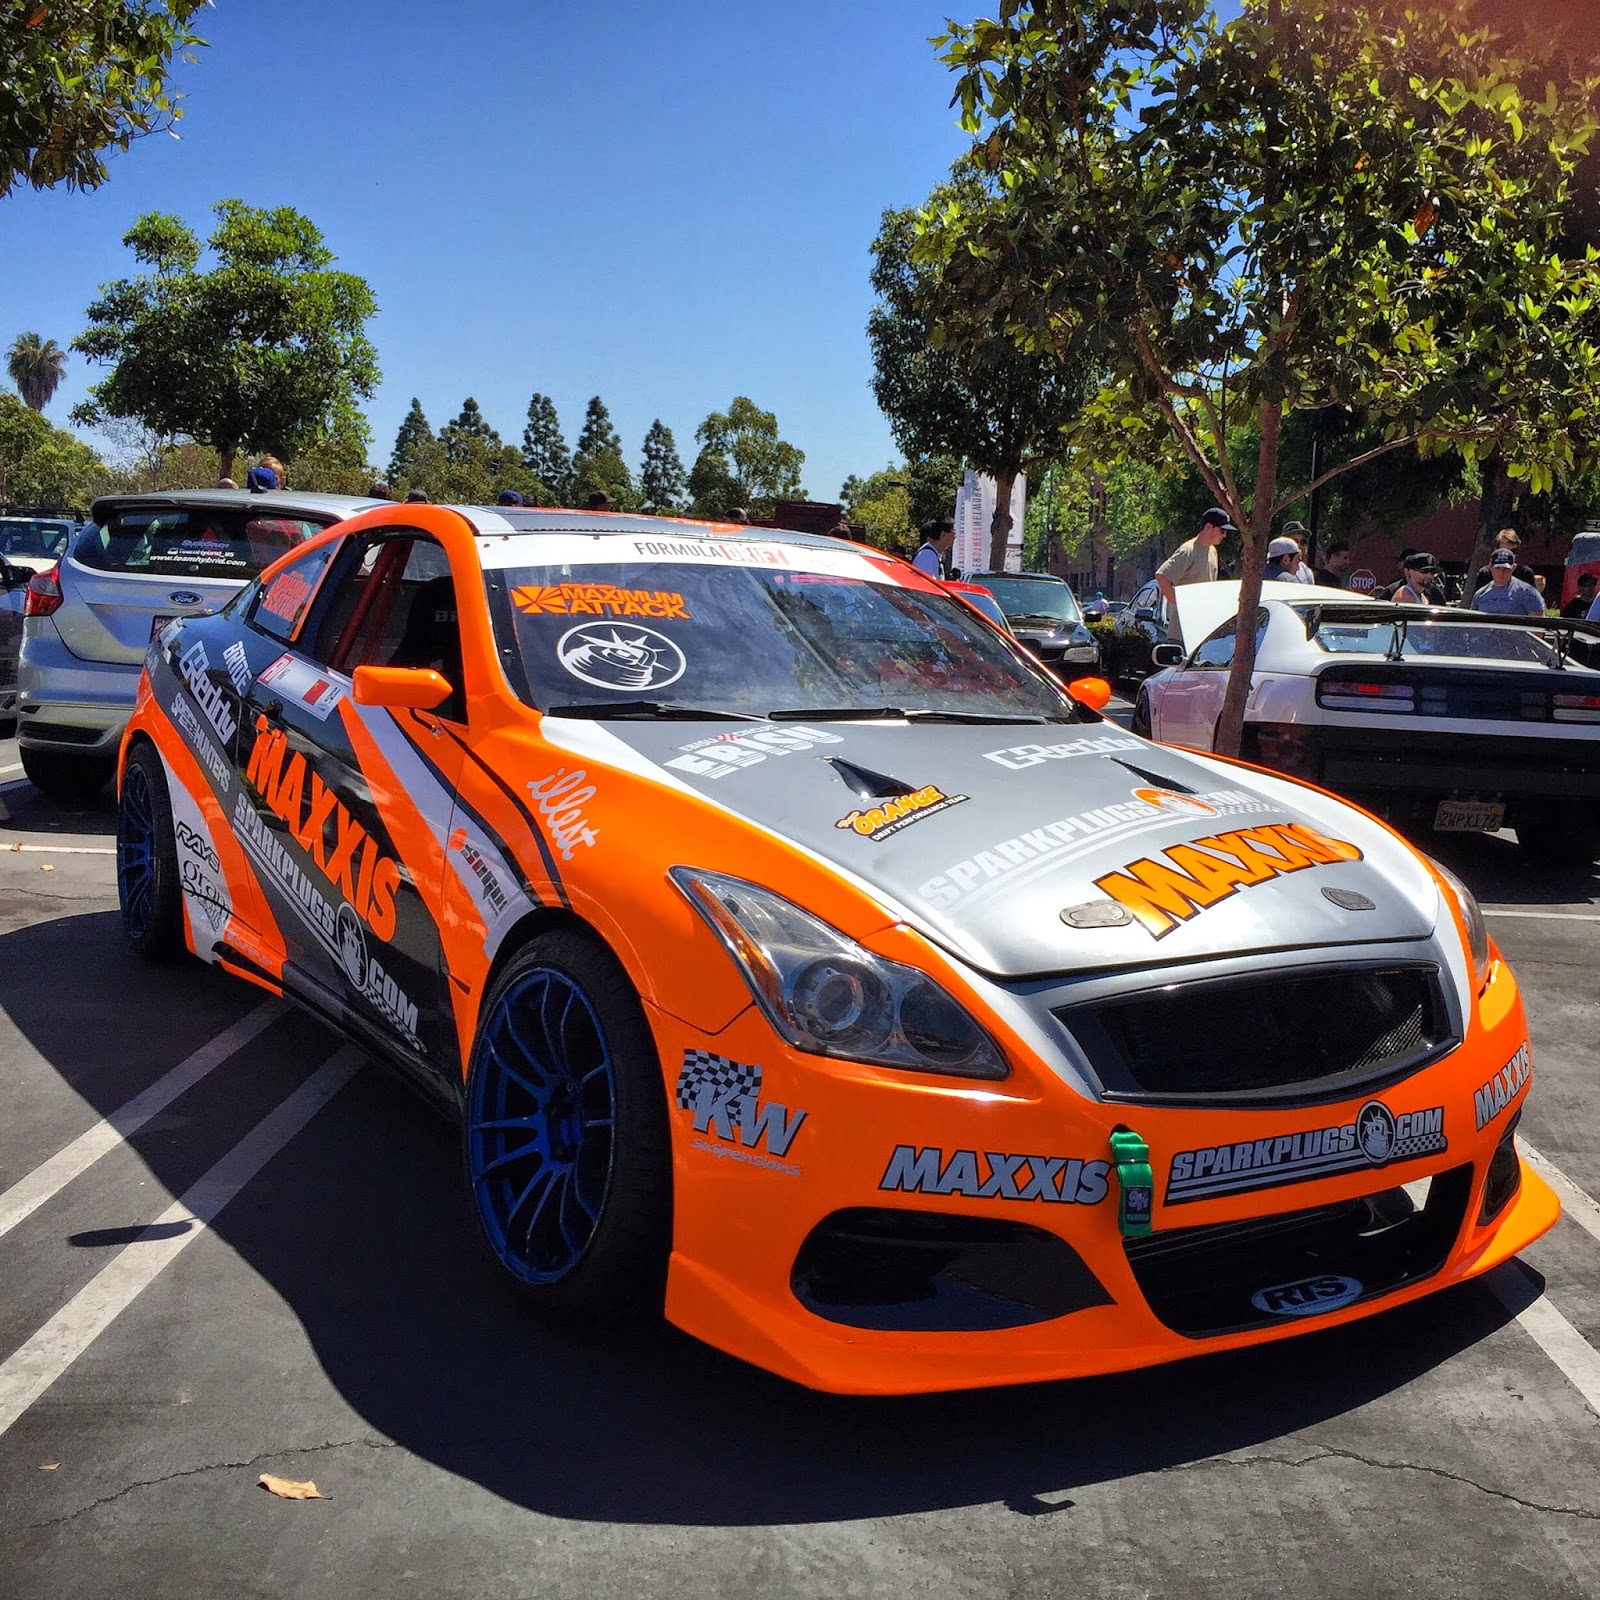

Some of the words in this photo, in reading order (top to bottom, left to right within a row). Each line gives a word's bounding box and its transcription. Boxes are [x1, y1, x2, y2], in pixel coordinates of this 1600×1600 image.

[150, 555, 247, 566] www.teamhybrid.com
[633, 542, 722, 558] FORMULA
[560, 586, 685, 605] MAXIMUM
[569, 599, 691, 620] ATTACK
[1352, 576, 1374, 590] STOP
[223, 640, 253, 696] BRIDE
[246, 730, 402, 943] MAXXIS
[526, 767, 601, 861] illest
[852, 785, 946, 836] ORANGE
[872, 826, 896, 841] DRIFT
[894, 802, 948, 830] PERFORMANCE
[946, 795, 968, 806] TEAM
[176, 821, 220, 874] RAYS
[233, 792, 337, 937] SPARKPLUGS
[916, 799, 1161, 903] SPARKPLUGS
[1092, 822, 1364, 941] MAXXIS
[692, 1080, 810, 1157] KW
[878, 1144, 1114, 1205] MAXXIS
[1170, 1123, 1357, 1182] SPARKPLUGS
[1261, 1276, 1349, 1311] RTS
